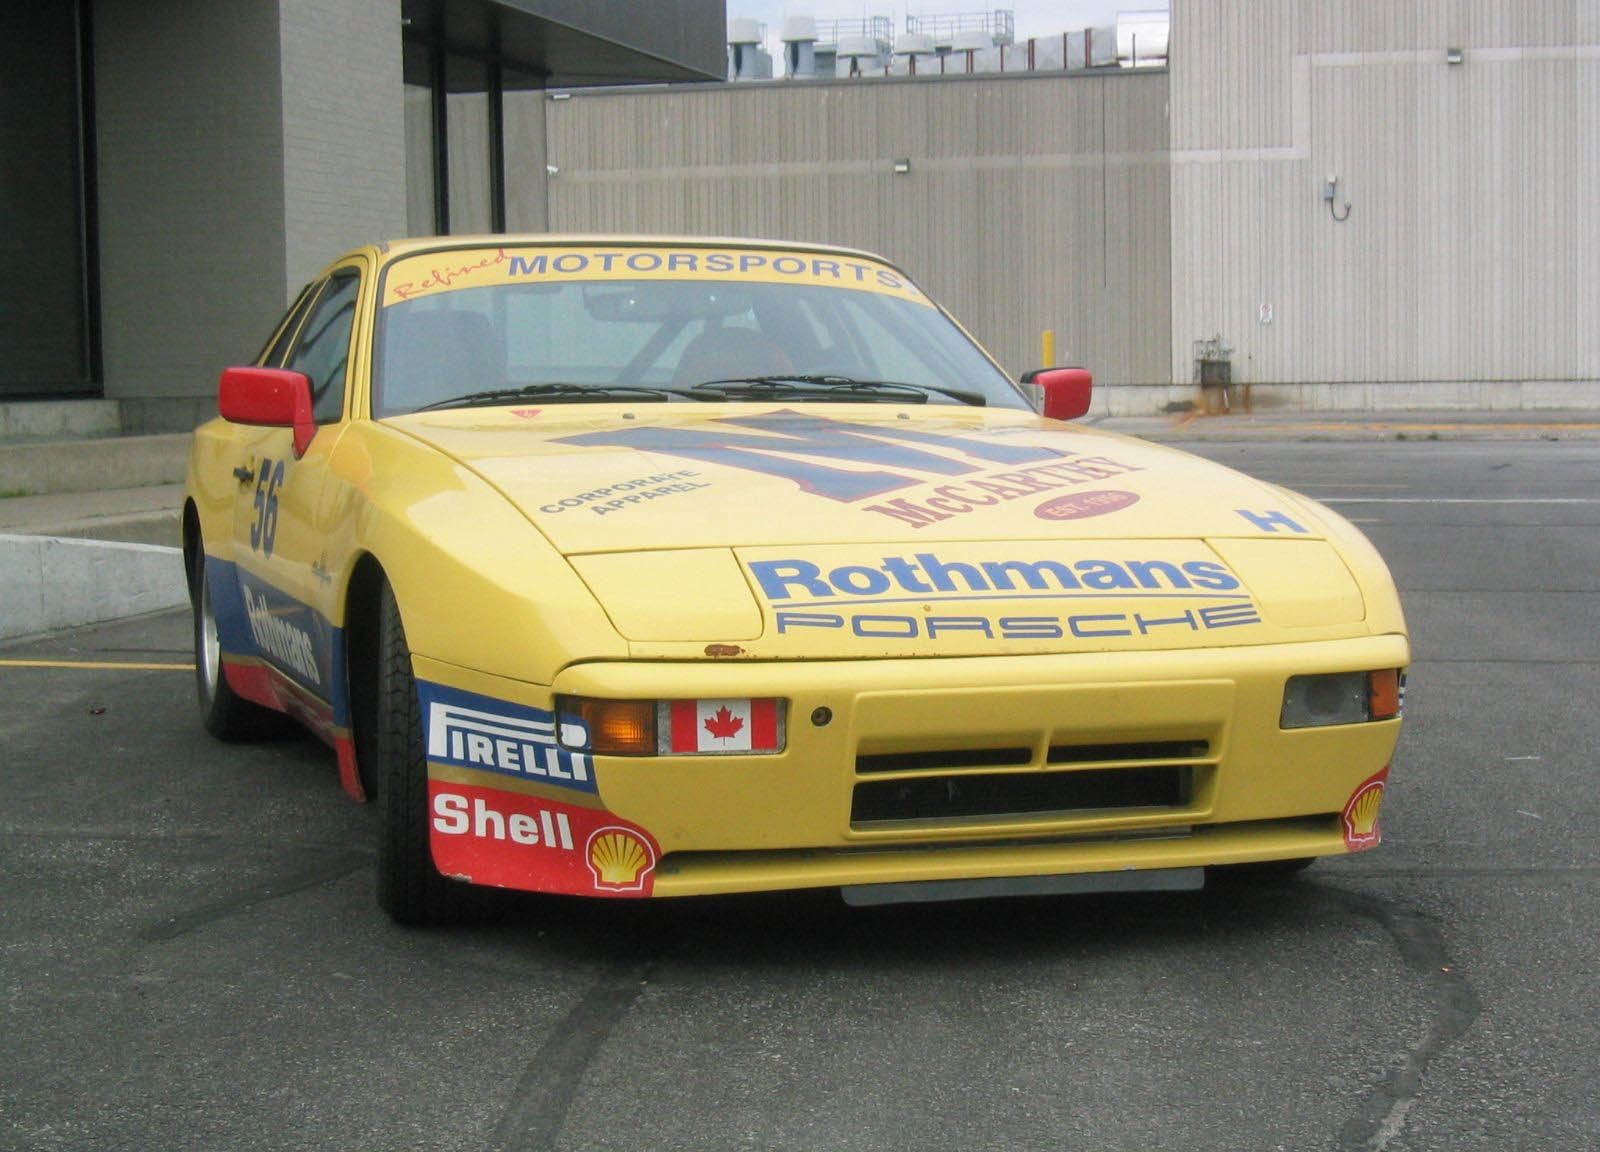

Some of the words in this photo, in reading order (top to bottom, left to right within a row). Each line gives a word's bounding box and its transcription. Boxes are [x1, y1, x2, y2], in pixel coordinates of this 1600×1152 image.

[393, 248, 512, 298] Refined
[508, 252, 903, 289] MOTORSPORTS
[250, 457, 285, 560] 56
[539, 470, 702, 514] CORPORATE
[591, 482, 713, 516] APPAREL
[1232, 509, 1310, 533] H
[747, 553, 1242, 600] Rothmans
[243, 583, 321, 686] Rothmans
[776, 603, 1262, 640] PORSCHE
[428, 701, 588, 782] PIRELLI
[433, 793, 575, 851] Shell
